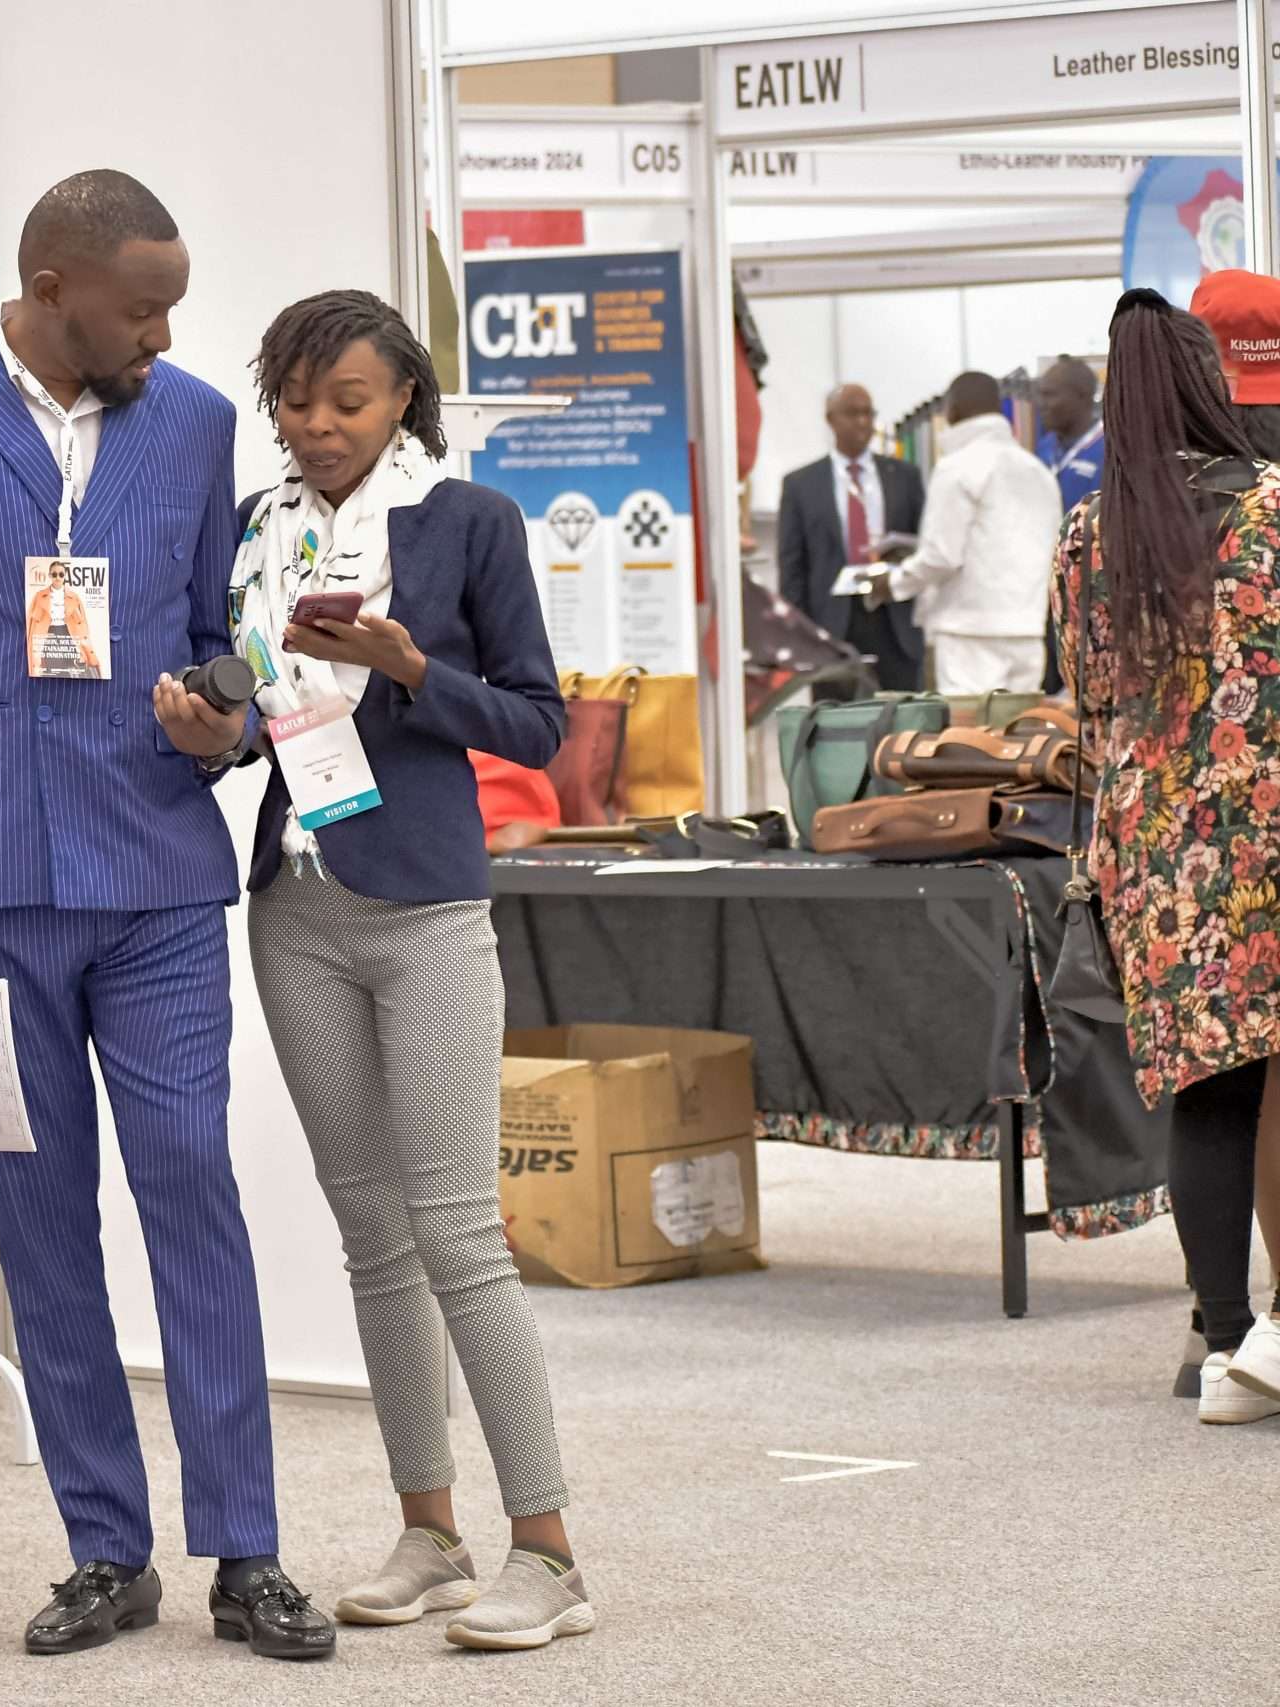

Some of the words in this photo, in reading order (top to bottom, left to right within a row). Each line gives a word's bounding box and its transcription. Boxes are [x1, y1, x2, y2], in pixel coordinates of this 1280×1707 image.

[1053, 51, 1136, 78] Leather
[1143, 42, 1240, 71] Blessing
[734, 57, 843, 110] EATLW
[460, 152, 539, 171] howcase
[545, 152, 584, 171] 2024
[632, 143, 681, 173] C05
[1230, 338, 1280, 351] KISUMU
[1243, 351, 1280, 361] TOYOTA
[63, 566, 106, 587] ASFW
[324, 800, 359, 818] VISITOR
[499, 1146, 578, 1178] safe
